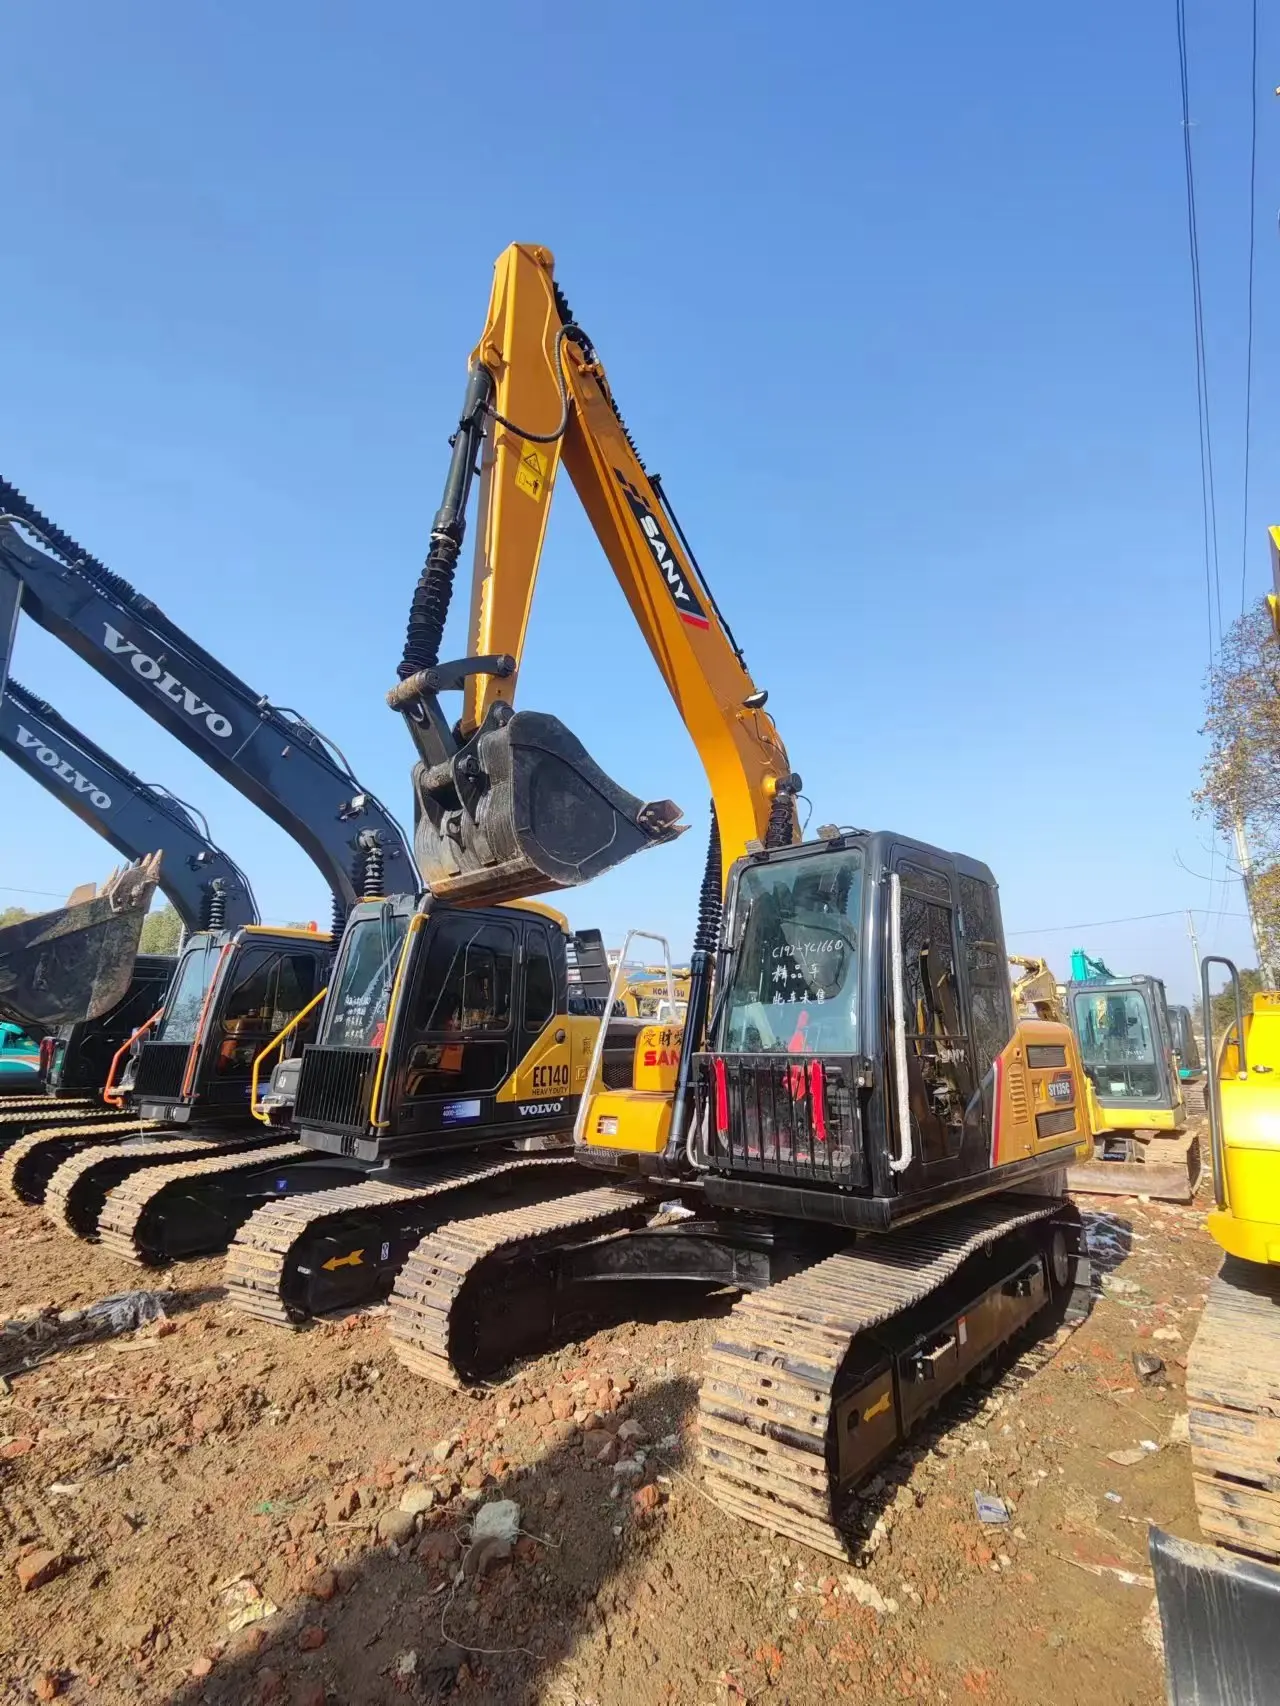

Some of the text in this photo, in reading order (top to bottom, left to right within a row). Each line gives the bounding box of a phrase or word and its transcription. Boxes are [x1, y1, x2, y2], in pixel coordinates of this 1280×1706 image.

[640, 515, 690, 601] SANY
[103, 621, 233, 738] VOLVO
[16, 724, 112, 809] VOLVO
[652, 987, 685, 998] KOMSU
[533, 1064, 569, 1088] EC140
[518, 1102, 562, 1116] VOLVO
